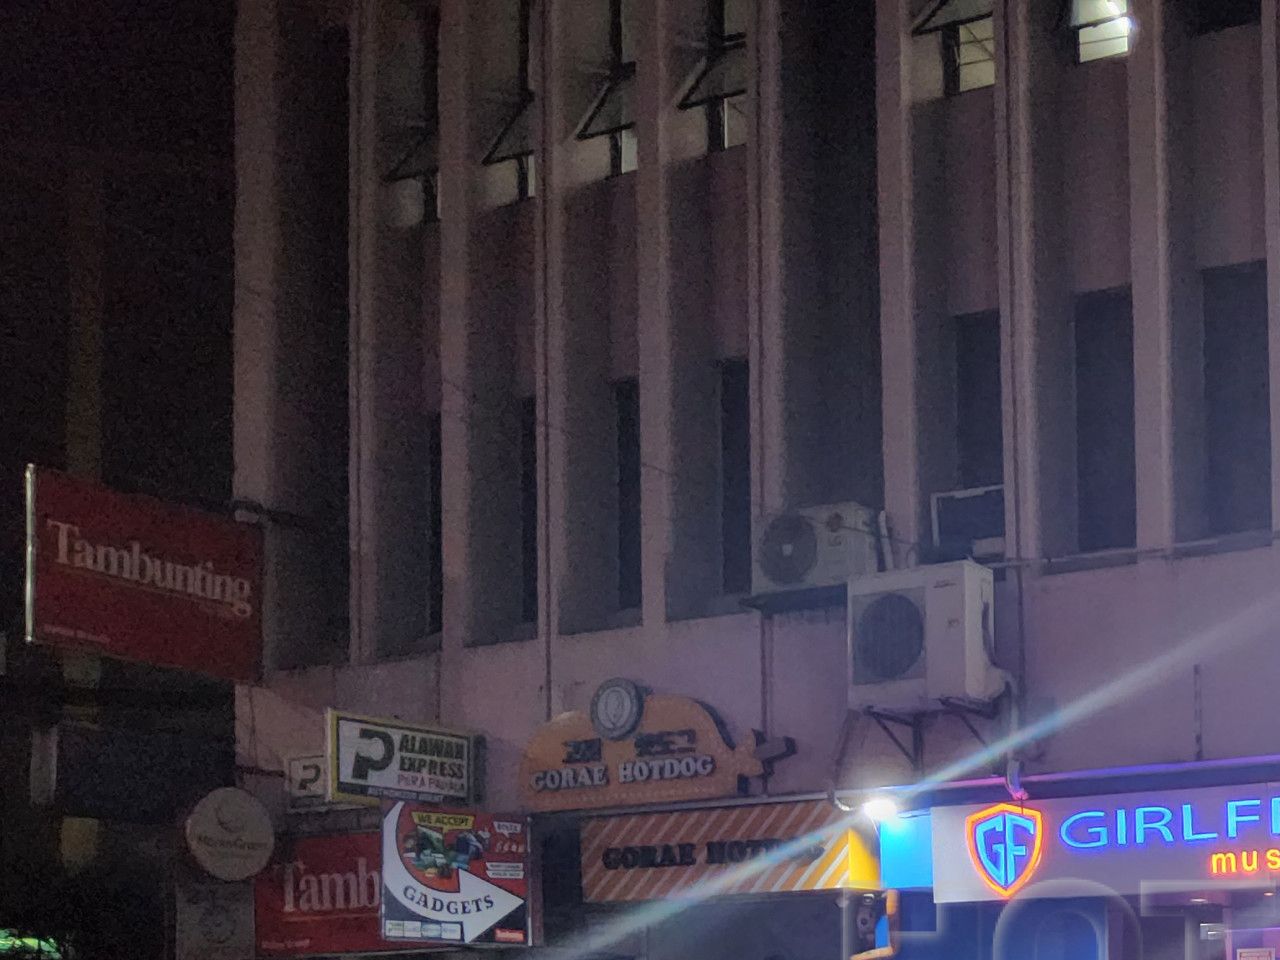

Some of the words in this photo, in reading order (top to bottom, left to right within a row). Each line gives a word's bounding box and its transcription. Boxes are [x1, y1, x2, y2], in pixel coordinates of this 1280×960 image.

[47, 518, 253, 618] Tambunting
[530, 766, 607, 792] GORAE
[617, 754, 715, 785] HOTDOG
[418, 813, 432, 825] WE
[434, 814, 471, 826] ACCEPT
[601, 843, 695, 870] GORAE
[975, 812, 1036, 888] GF
[402, 885, 495, 915] GADGETS
